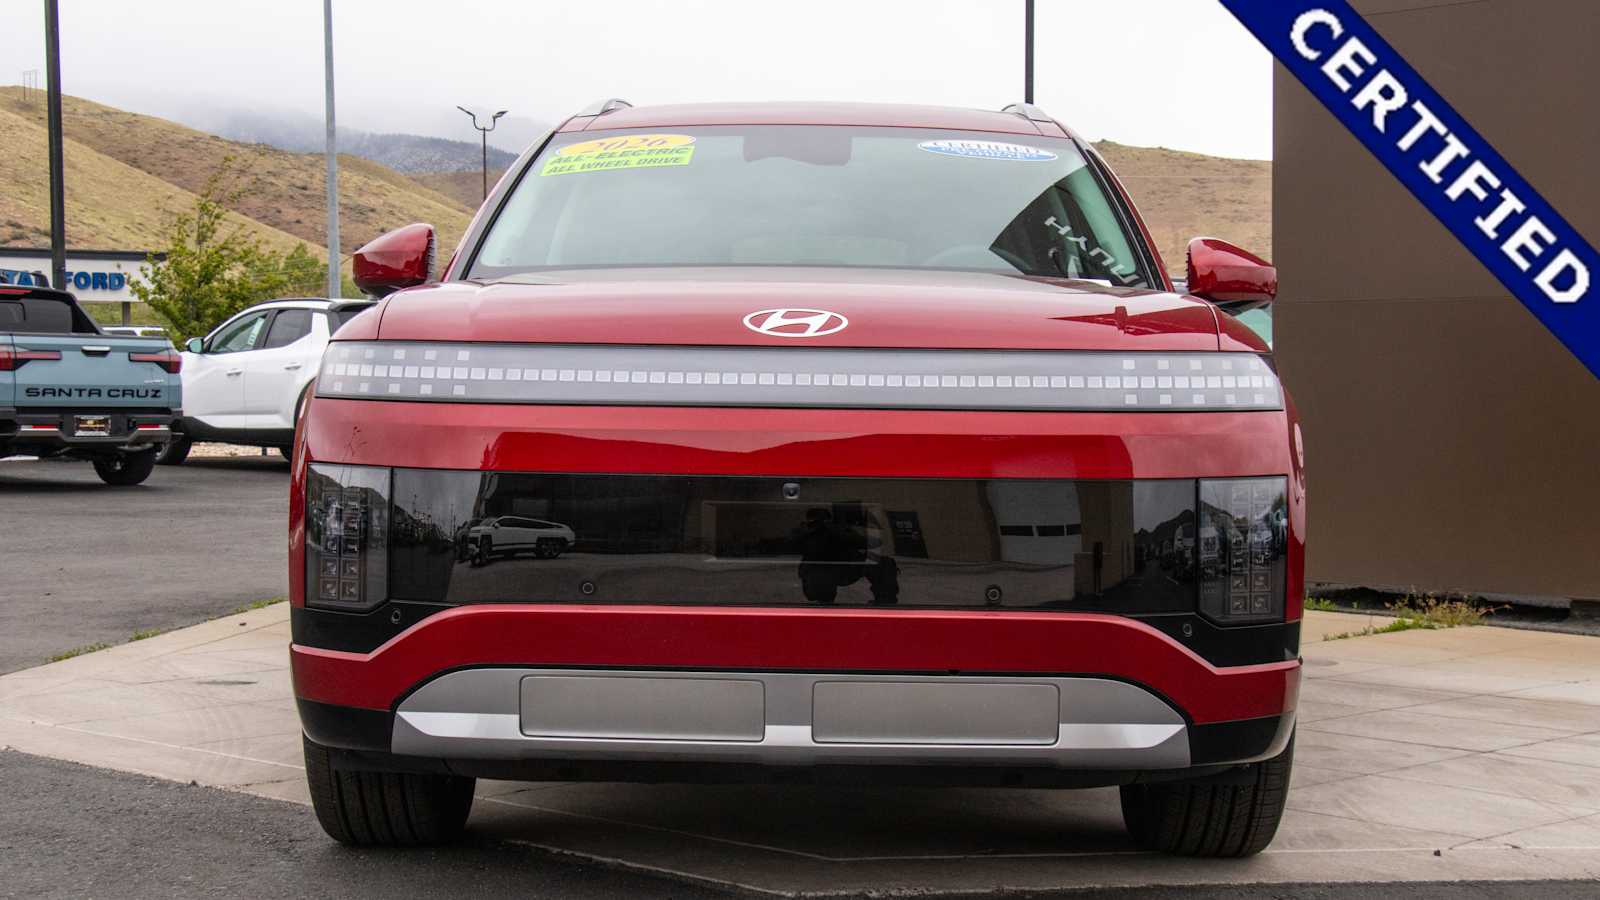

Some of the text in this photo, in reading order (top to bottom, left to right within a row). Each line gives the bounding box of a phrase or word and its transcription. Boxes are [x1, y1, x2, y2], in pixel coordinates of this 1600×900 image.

[550, 147, 688, 164] ALL-ELECTRIC
[547, 156, 681, 174] ALL WHEEL DRIVE
[65, 271, 126, 290] FORD
[25, 387, 162, 399] SANTA CRUZ
